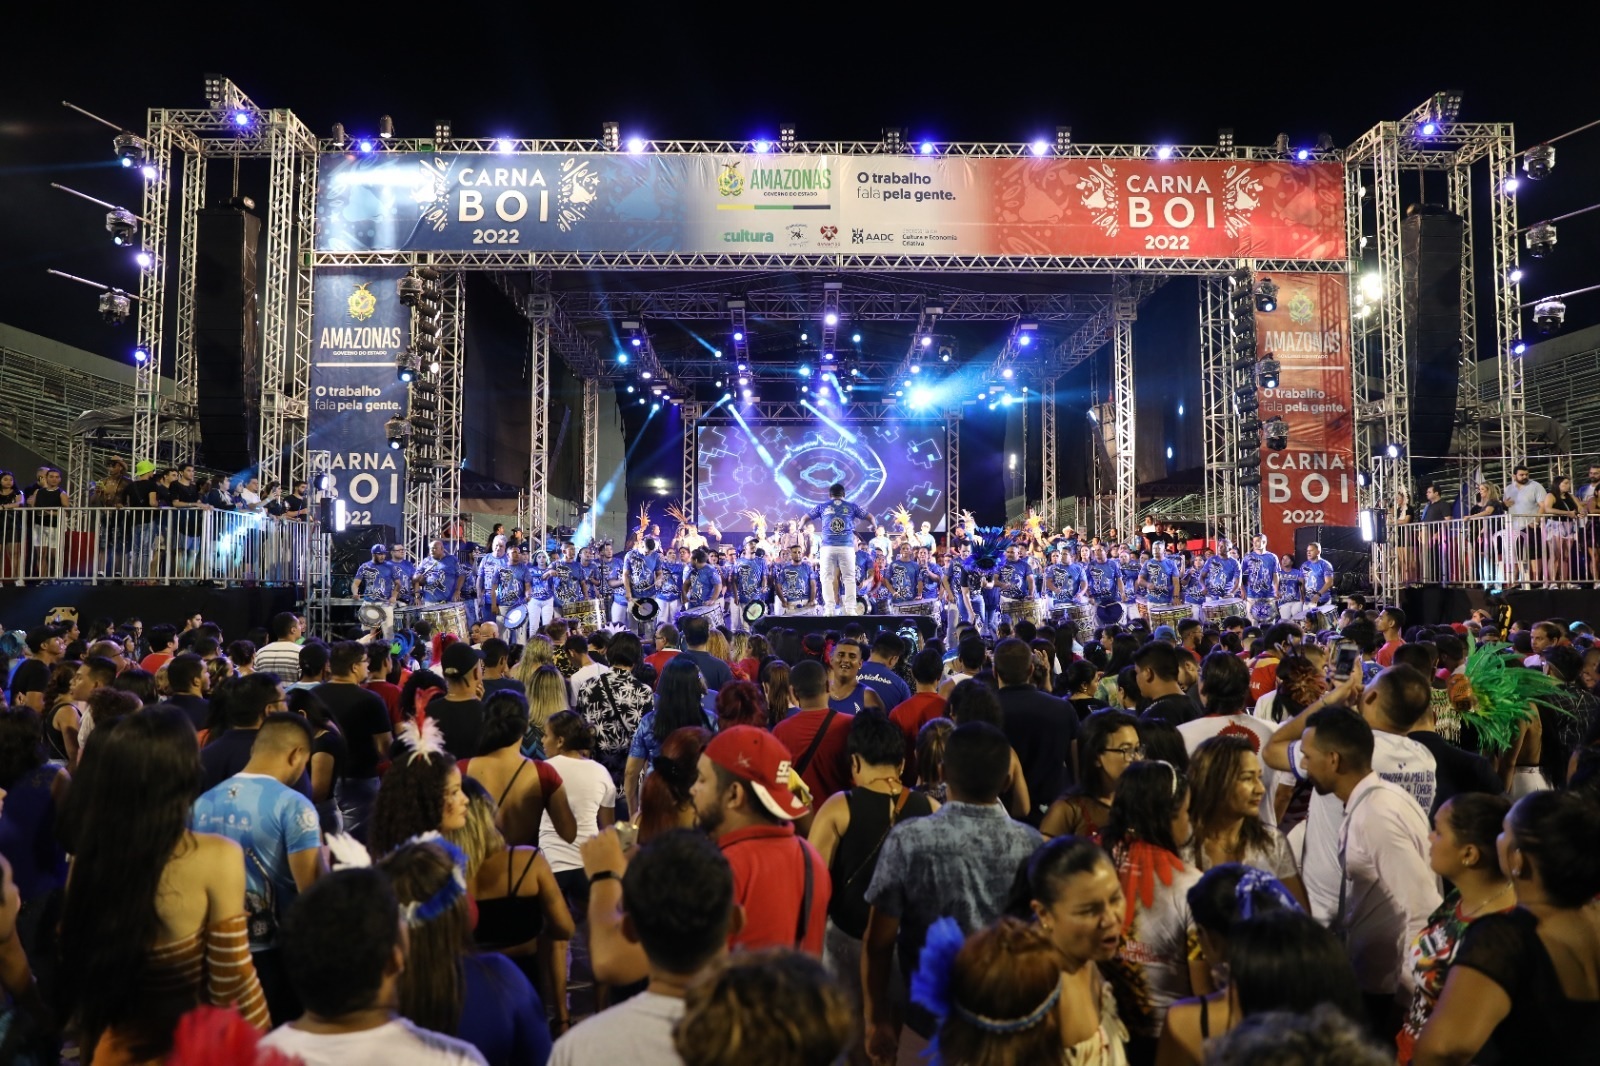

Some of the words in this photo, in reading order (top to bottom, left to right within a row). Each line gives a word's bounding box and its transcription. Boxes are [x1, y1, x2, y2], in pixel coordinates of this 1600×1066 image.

[458, 168, 547, 187] CARNA
[750, 168, 832, 190] AMAZONAS
[857, 171, 870, 184] O
[872, 172, 932, 184] trabalho
[1126, 175, 1211, 194] CARNA
[857, 186, 881, 199] fala
[883, 188, 912, 202] pela
[914, 190, 956, 203] gente.
[458, 190, 549, 222] BOI
[1128, 196, 1215, 229] BOI
[472, 228, 520, 244] 2022
[723, 229, 774, 243] cultura
[865, 233, 894, 241] AADC
[1144, 235, 1190, 250] 2022
[320, 327, 401, 349] AMAZONAS
[1264, 330, 1341, 353] AMAZONAS
[315, 386, 327, 397] O
[328, 385, 381, 397] trabalho
[1263, 388, 1273, 399] O
[1275, 388, 1326, 399] trabalho
[315, 398, 336, 410] fala
[337, 399, 363, 412] pela
[365, 400, 402, 413] gente.
[1262, 400, 1283, 412] fala
[1284, 402, 1309, 413] pela
[1310, 402, 1347, 414] gente.
[314, 452, 397, 470] CARNA
[1266, 452, 1345, 470] CARNA
[1268, 472, 1349, 504] BOI
[1282, 509, 1325, 524] 2022
